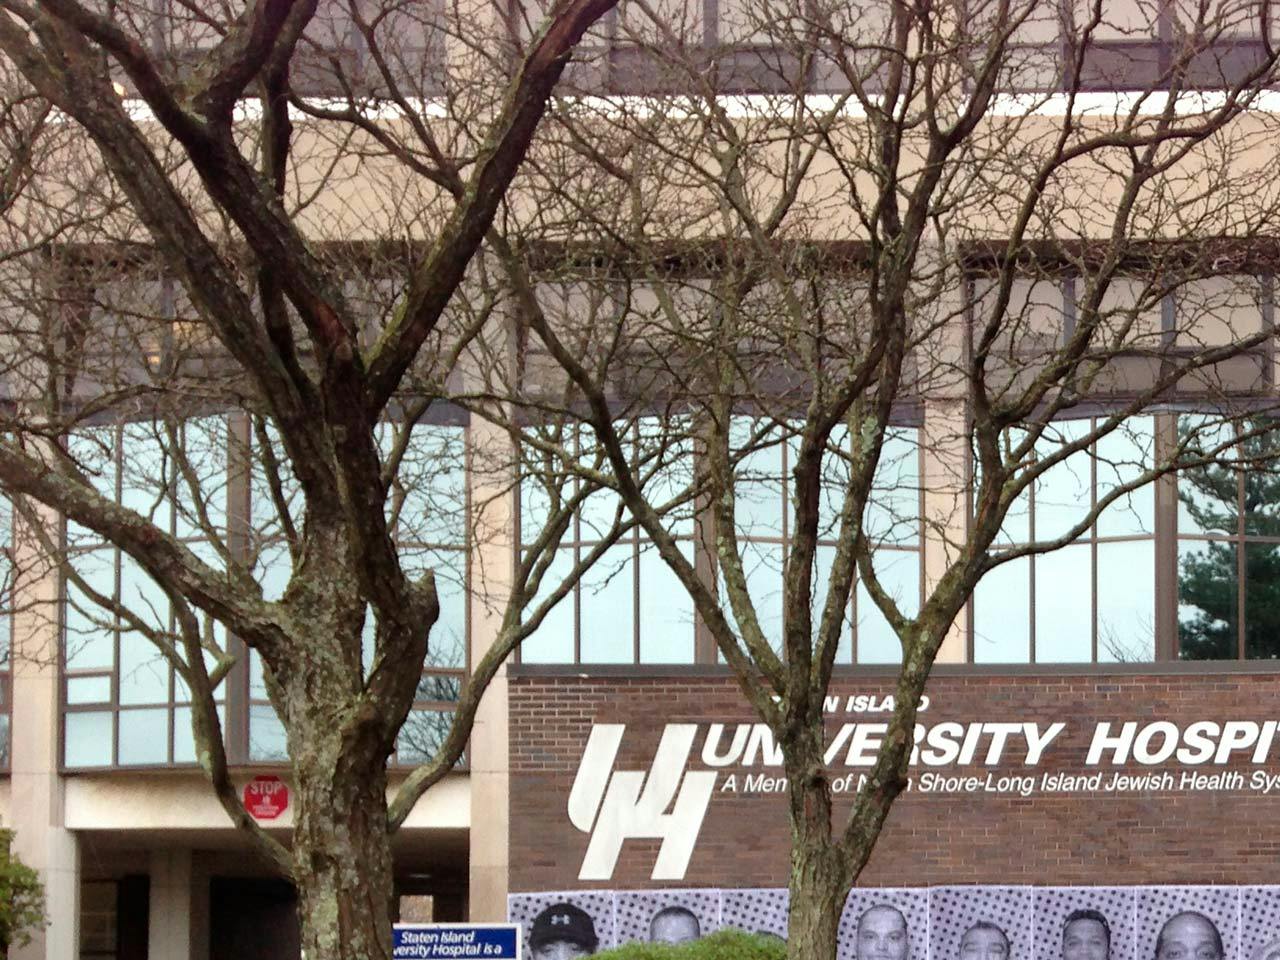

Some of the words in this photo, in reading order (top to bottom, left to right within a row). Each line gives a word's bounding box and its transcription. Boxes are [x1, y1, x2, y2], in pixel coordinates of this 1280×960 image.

[845, 695, 930, 712] ISLAD
[250, 781, 281, 795] STOP
[721, 776, 737, 793] A
[831, 773, 854, 793] of
[918, 772, 1034, 797] Shore-Long
[1040, 771, 1102, 791] Island
[1104, 771, 1174, 792] Jewish
[1178, 770, 1244, 790] Health
[401, 931, 439, 944] Staten
[441, 931, 475, 944] Island
[432, 944, 480, 958] Hospital
[484, 943, 492, 955] is
[494, 946, 502, 955] a
